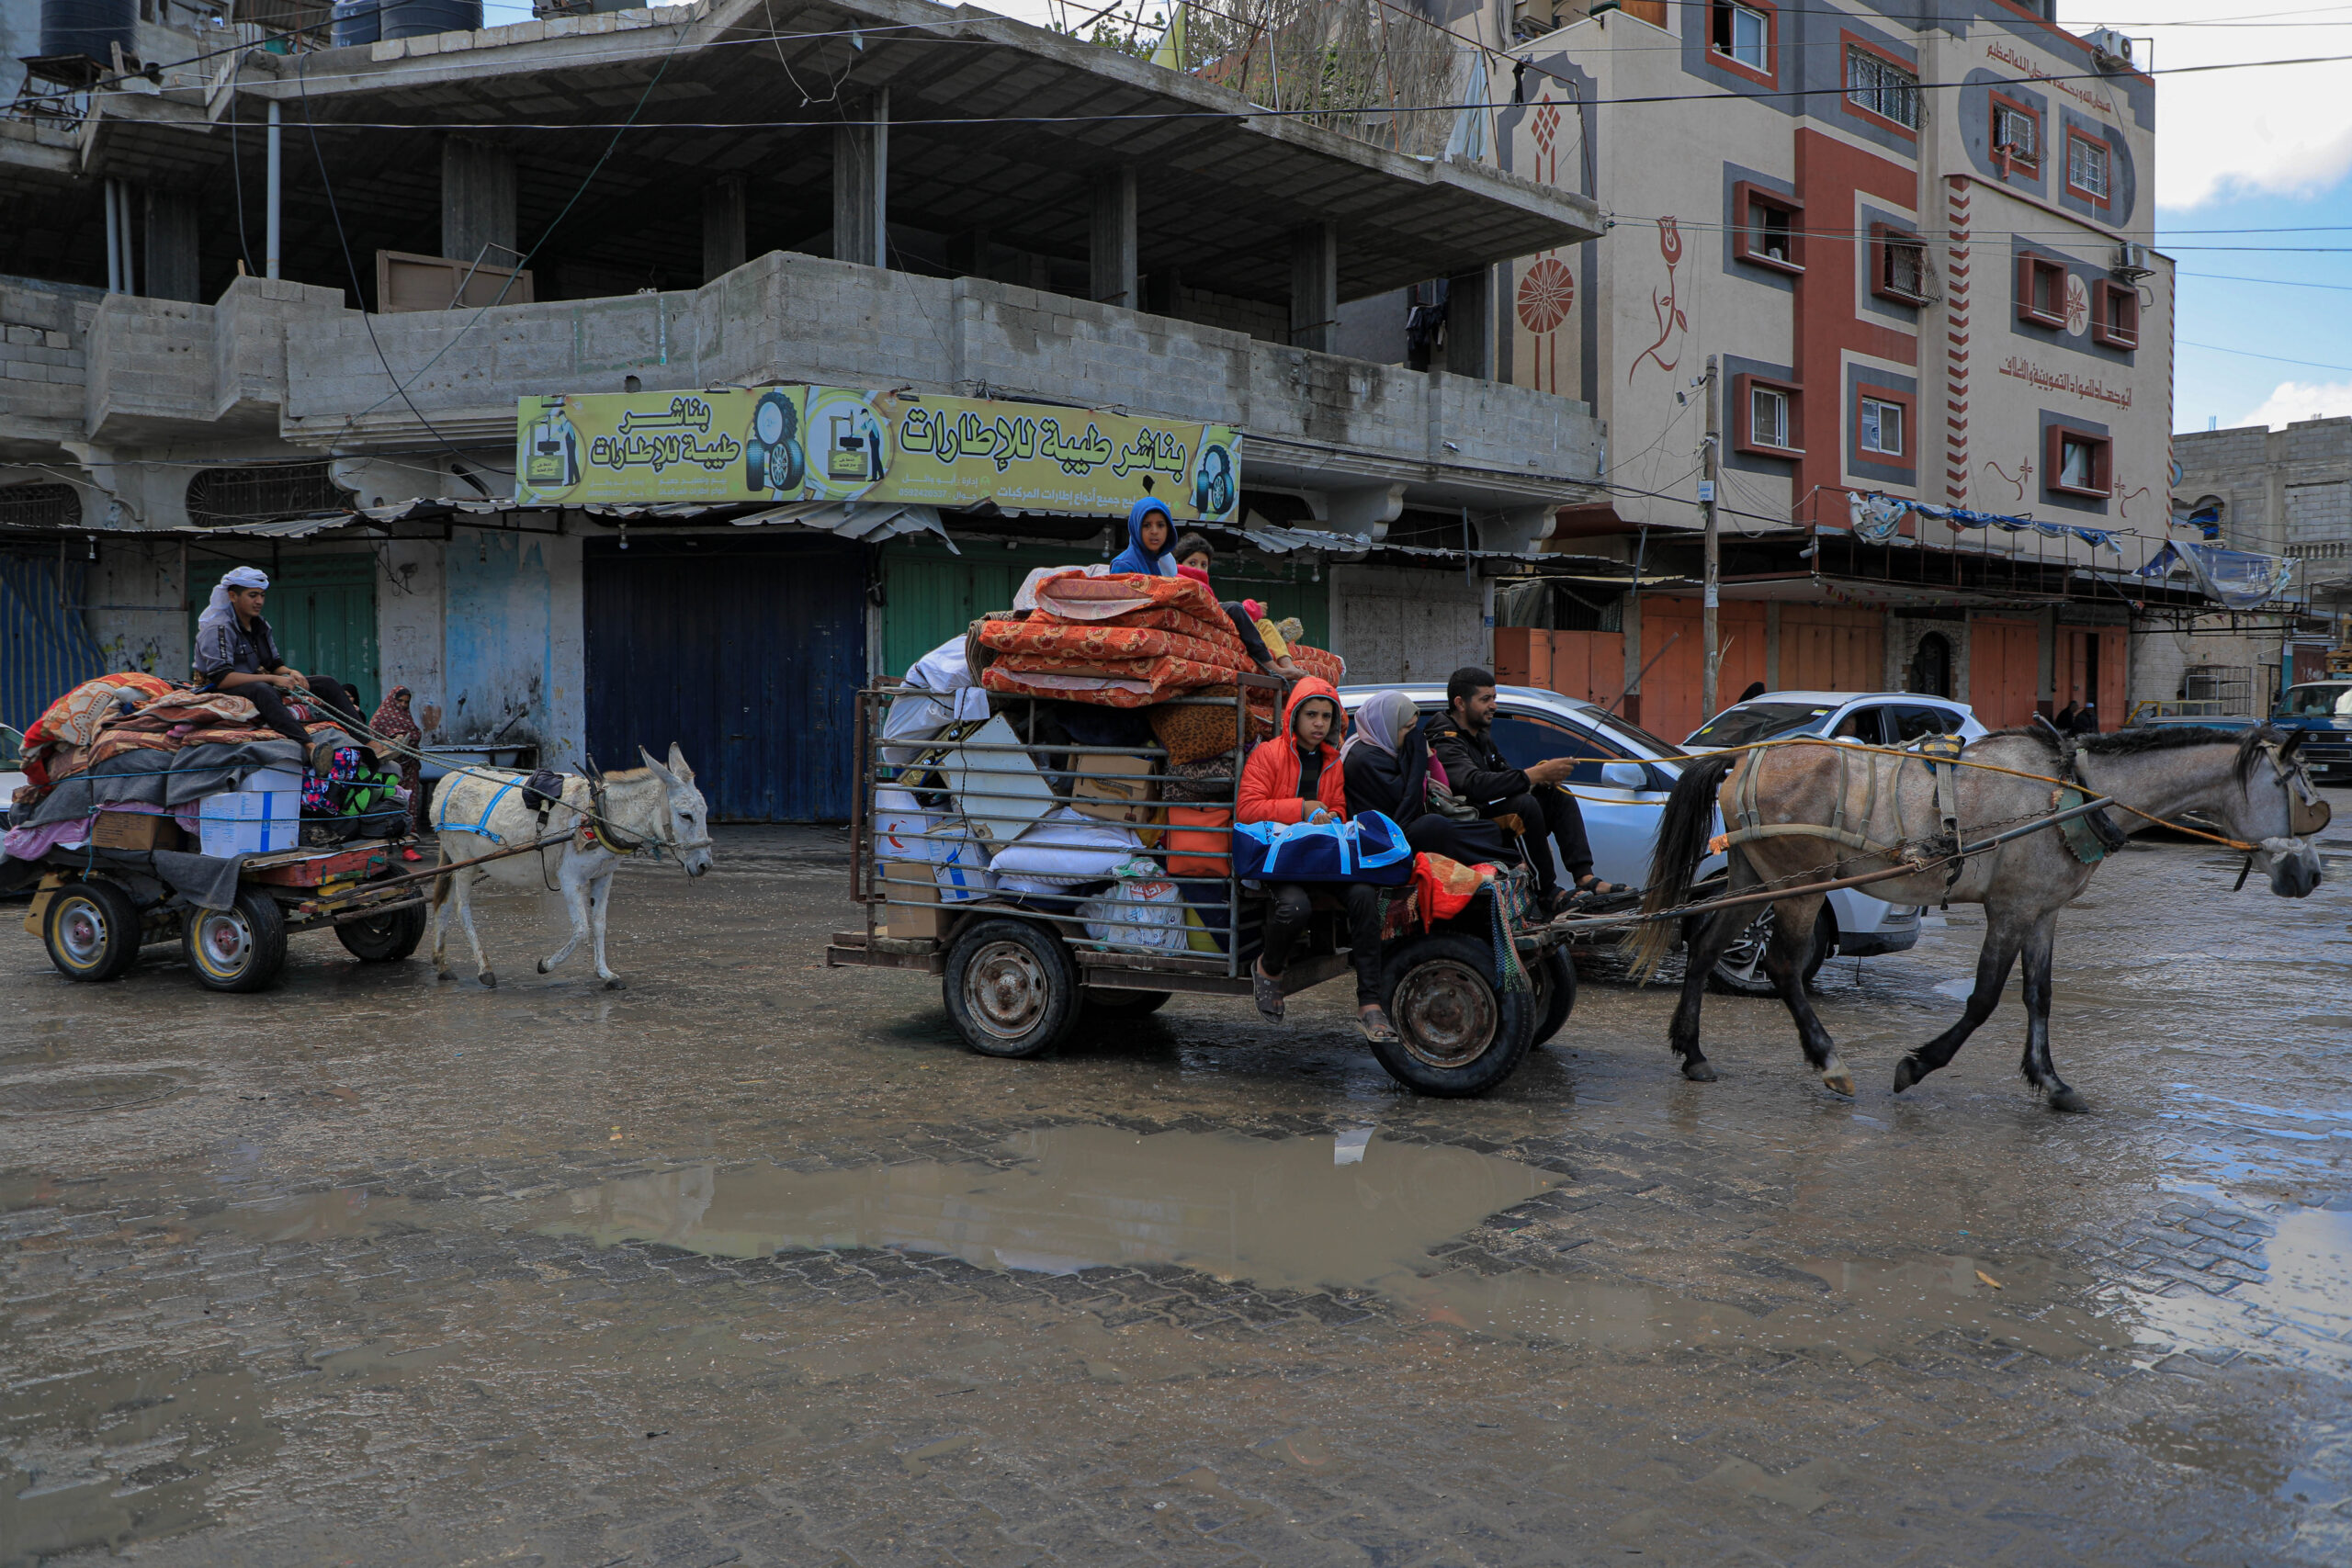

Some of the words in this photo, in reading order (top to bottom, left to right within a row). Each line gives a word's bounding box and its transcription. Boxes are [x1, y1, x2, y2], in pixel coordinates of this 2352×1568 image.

[617, 397, 711, 434] بناشر
[590, 434, 681, 473] للإطارات
[681, 433, 741, 469] طيبة
[900, 408, 1037, 472] للإطارات
[1039, 418, 1113, 475] طيبة
[1112, 427, 1186, 483] بناشر
[996, 486, 1040, 502] المركبات
